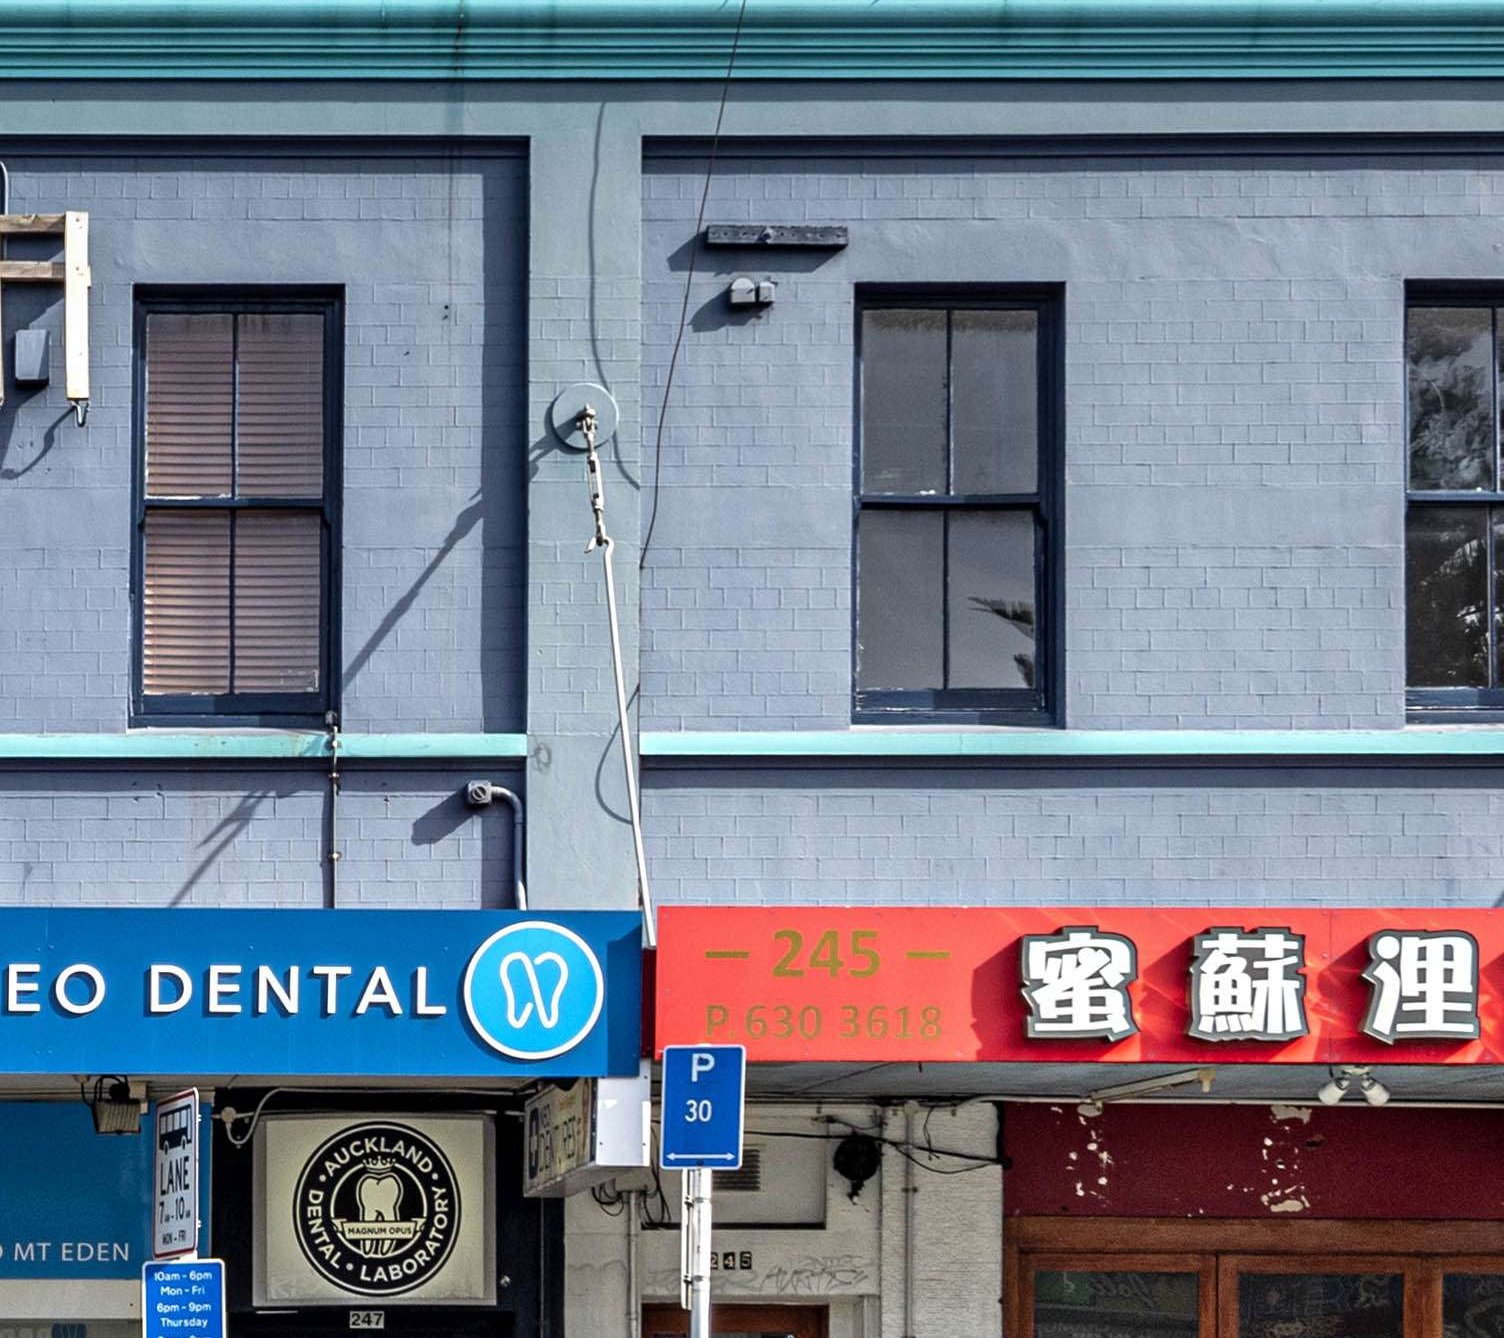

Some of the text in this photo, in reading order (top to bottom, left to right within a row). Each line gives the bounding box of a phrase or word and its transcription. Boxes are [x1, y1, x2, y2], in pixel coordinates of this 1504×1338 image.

[772, 928, 881, 979] 245
[150, 964, 447, 1015] DENTAL
[839, 1005, 943, 1040] 3618
[692, 1052, 714, 1082] P
[685, 1099, 713, 1122] 30
[323, 1136, 433, 1177] AUCKLAND
[160, 1155, 190, 1197] LANE
[307, 1189, 340, 1270] DENTAL
[347, 1226, 412, 1236] MAGNUM OPUS
[360, 1186, 449, 1282] LABORATORY
[14, 1242, 50, 1261] MT
[61, 1241, 130, 1261] EDEN
[154, 1271, 180, 1281] 10am
[189, 1270, 213, 1281] 6pm
[160, 1286, 183, 1295] Mon
[192, 1285, 205, 1295] Fri
[156, 1302, 180, 1313] 6pm
[188, 1302, 212, 1313] 9pm
[351, 1313, 383, 1326] 247
[160, 1317, 208, 1328] Thursday
